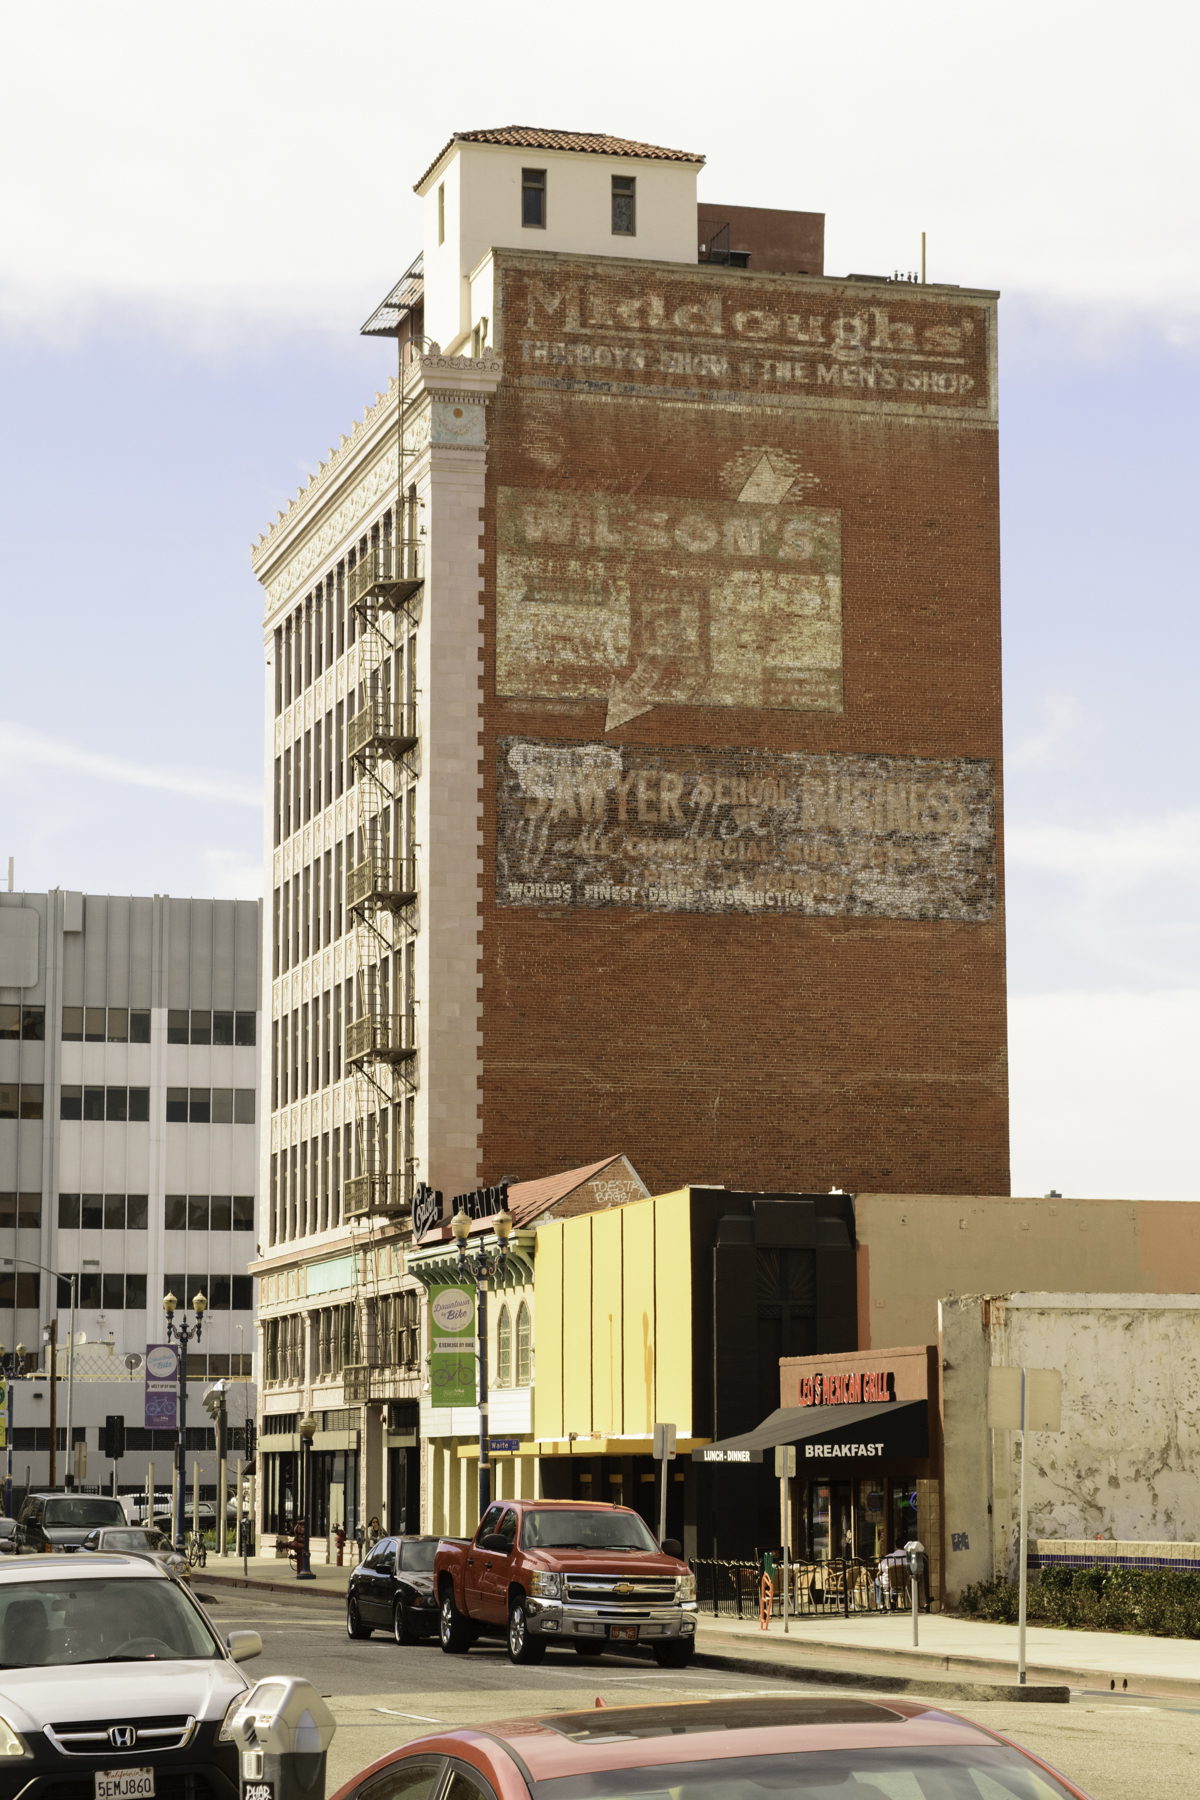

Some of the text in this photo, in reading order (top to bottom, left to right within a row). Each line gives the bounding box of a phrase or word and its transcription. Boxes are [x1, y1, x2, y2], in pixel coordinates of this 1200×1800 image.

[759, 358, 809, 384] THE
[816, 362, 899, 390] MEN'S
[902, 370, 975, 395] SHOP
[523, 764, 687, 824] SAWYER
[697, 773, 796, 809] SCHOOL
[508, 880, 572, 899] WORLD'S
[584, 883, 640, 902] FINEST
[449, 1184, 507, 1220] THEATRE
[433, 1299, 471, 1313] Downtown
[446, 1308, 467, 1320] Bike
[157, 1360, 172, 1370] Bike
[798, 1371, 890, 1406] LEO'S MEXICAN GRILL
[491, 1441, 509, 1450] Waite
[805, 1443, 885, 1458] BREAKFAST
[703, 1449, 751, 1462] LUNCH DINNER
[106, 1770, 144, 1780] California
[98, 1777, 152, 1797] 5EMJ860
